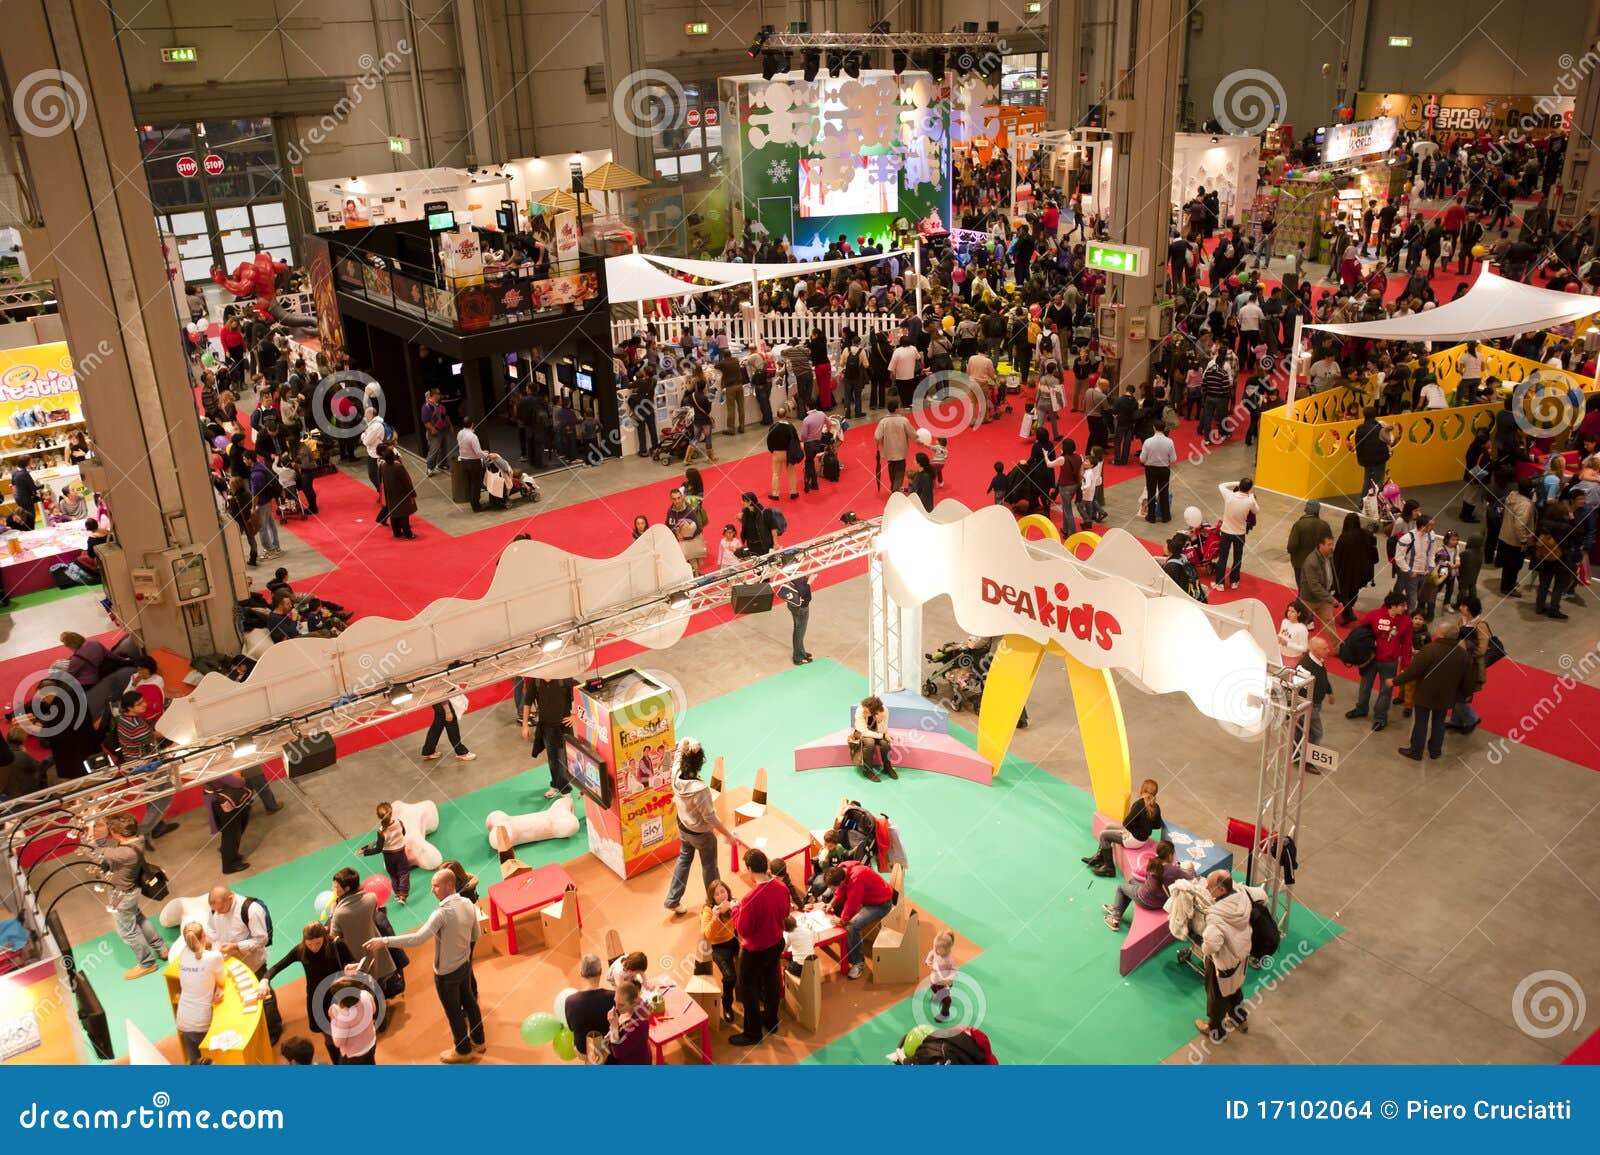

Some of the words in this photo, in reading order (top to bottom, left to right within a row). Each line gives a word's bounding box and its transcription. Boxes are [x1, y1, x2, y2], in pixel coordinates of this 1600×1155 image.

[1424, 104, 1481, 118] Game
[1435, 117, 1491, 130] SHOW
[178, 162, 197, 172] STOP
[205, 160, 224, 169] STOP
[982, 576, 1122, 651] DeAkids
[1312, 750, 1333, 765] B51
[643, 823, 662, 838] sky
